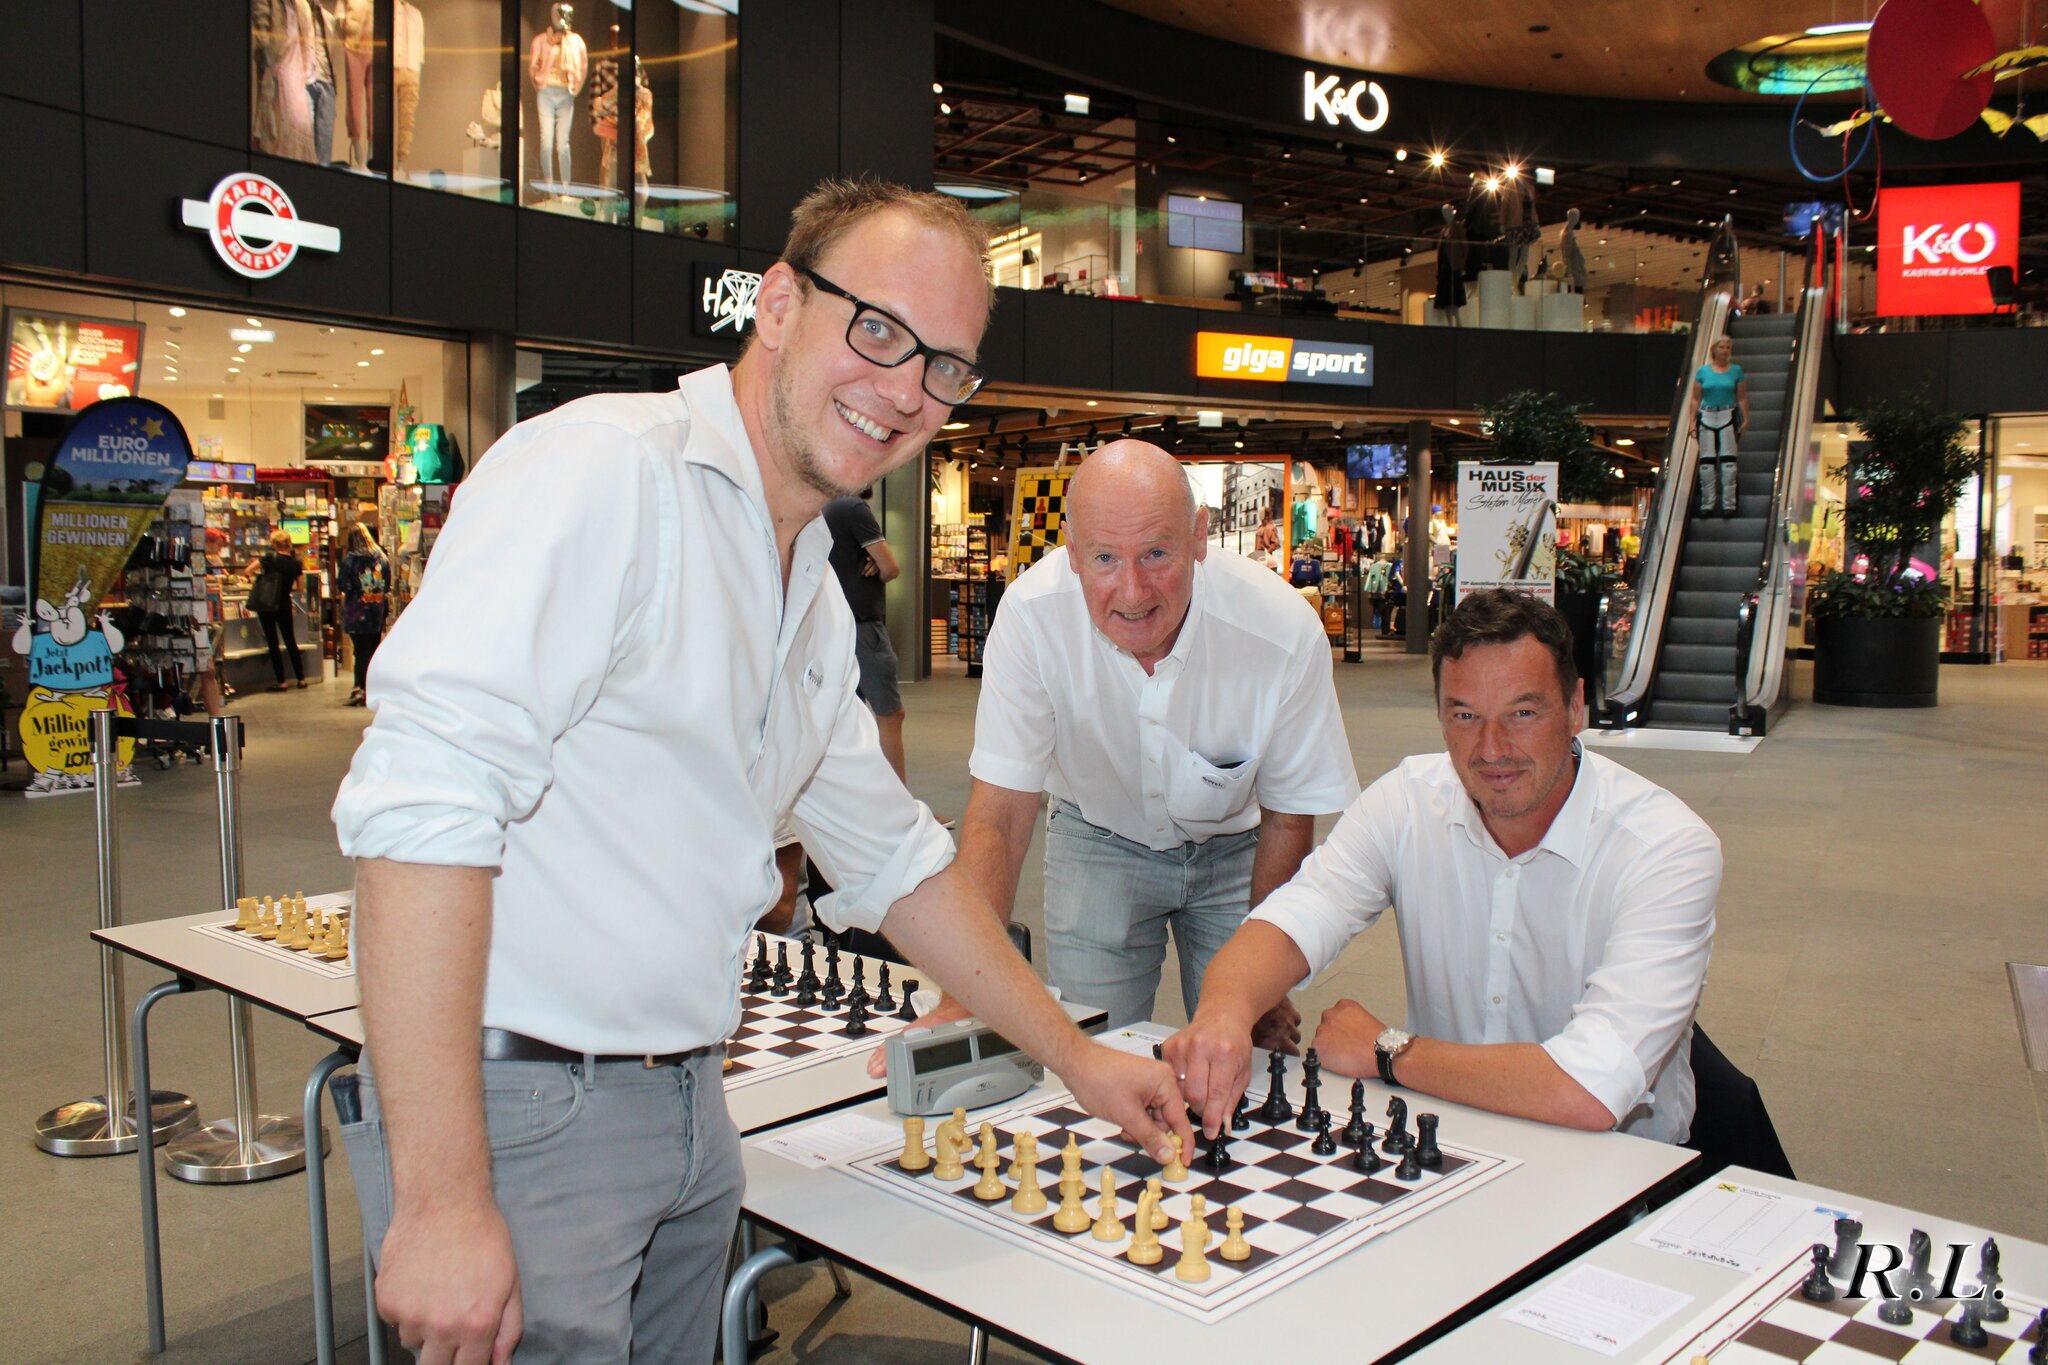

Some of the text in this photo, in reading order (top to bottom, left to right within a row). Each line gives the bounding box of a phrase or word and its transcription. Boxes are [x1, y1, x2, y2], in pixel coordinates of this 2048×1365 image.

[1304, 70, 1390, 132] K&O
[223, 180, 288, 213] TABAK
[221, 224, 288, 270] TRAFIK
[1902, 221, 1998, 265] K&O
[1222, 342, 1367, 377] giga sport
[98, 435, 148, 450] EURO
[71, 447, 170, 466] MILLIONEN
[1468, 470, 1548, 481] HAUS der
[1481, 481, 1547, 493] MUSIK
[51, 512, 129, 530] MILLIONEN
[46, 530, 131, 547] GEWINNEN!
[32, 655, 110, 681] Jackpot!
[31, 713, 86, 737] Millio
[64, 751, 92, 768] LOT
